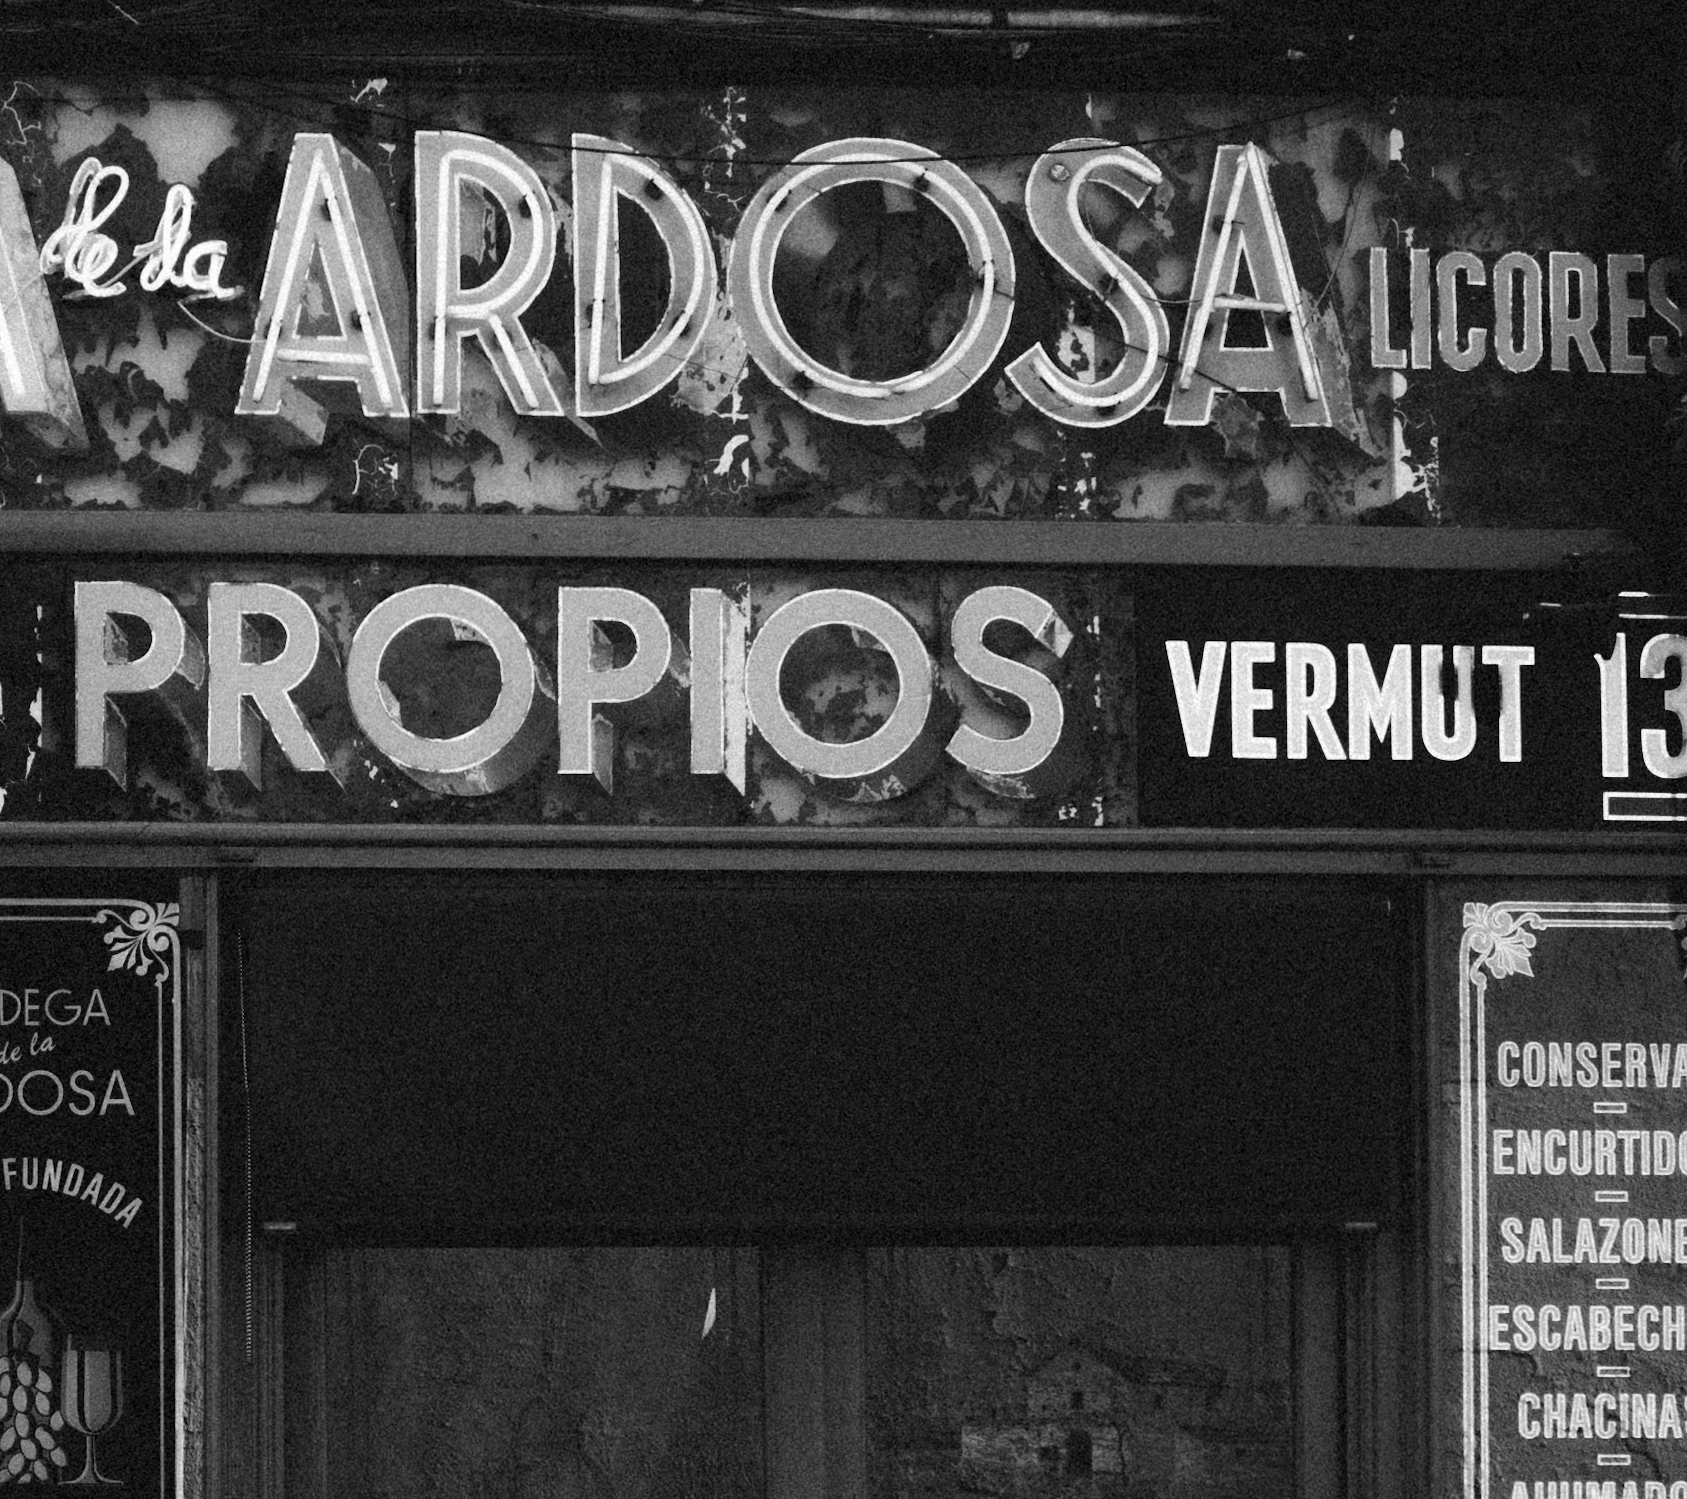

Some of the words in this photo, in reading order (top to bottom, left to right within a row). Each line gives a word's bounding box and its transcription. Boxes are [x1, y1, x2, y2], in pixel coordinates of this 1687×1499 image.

[234, 127, 1336, 429] ARDOSA
[1369, 247, 1687, 375] LICORES
[73, 579, 1074, 789] PROPIOS
[1164, 639, 1536, 763] VERMUT
[28, 1031, 56, 1057] la
[1, 1156, 144, 1230] FUNDADA
[1517, 1390, 1687, 1440] CHACINA
